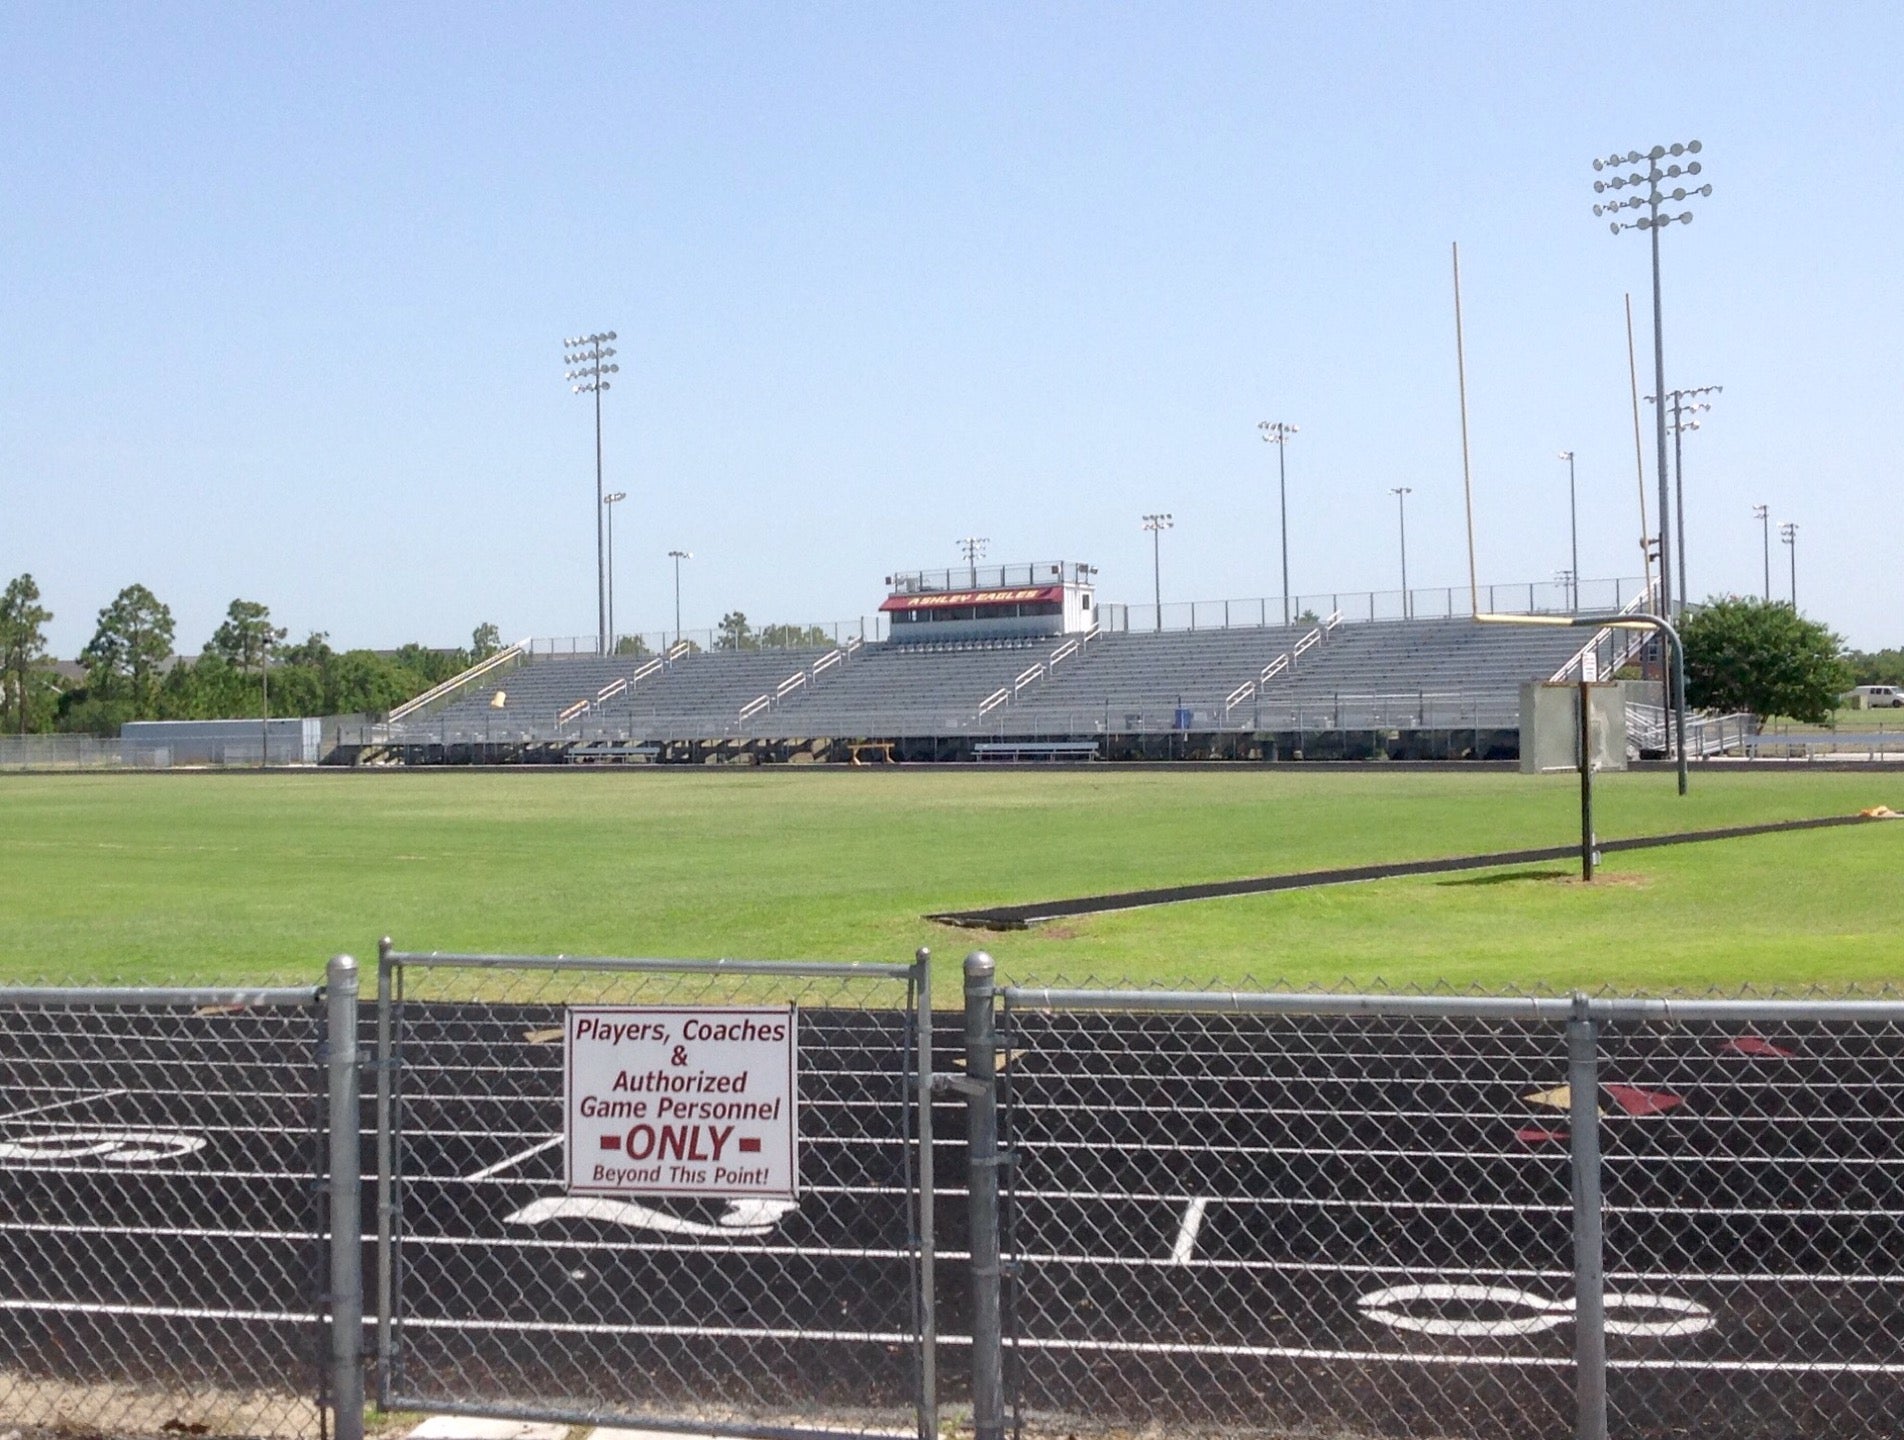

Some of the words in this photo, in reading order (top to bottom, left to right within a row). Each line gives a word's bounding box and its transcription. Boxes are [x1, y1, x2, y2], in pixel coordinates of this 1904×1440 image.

[908, 594, 972, 606] ASHLEY
[975, 589, 1040, 601] EAGLES
[576, 1019, 671, 1045] Players,
[683, 1019, 785, 1042] Coaches
[671, 1045, 688, 1067] &
[612, 1070, 748, 1093] Authorized
[580, 1096, 647, 1118] Game
[657, 1097, 781, 1120] Personnel
[593, 1165, 661, 1185] Beyond
[669, 1166, 706, 1183] This
[714, 1167, 769, 1185] Point!
